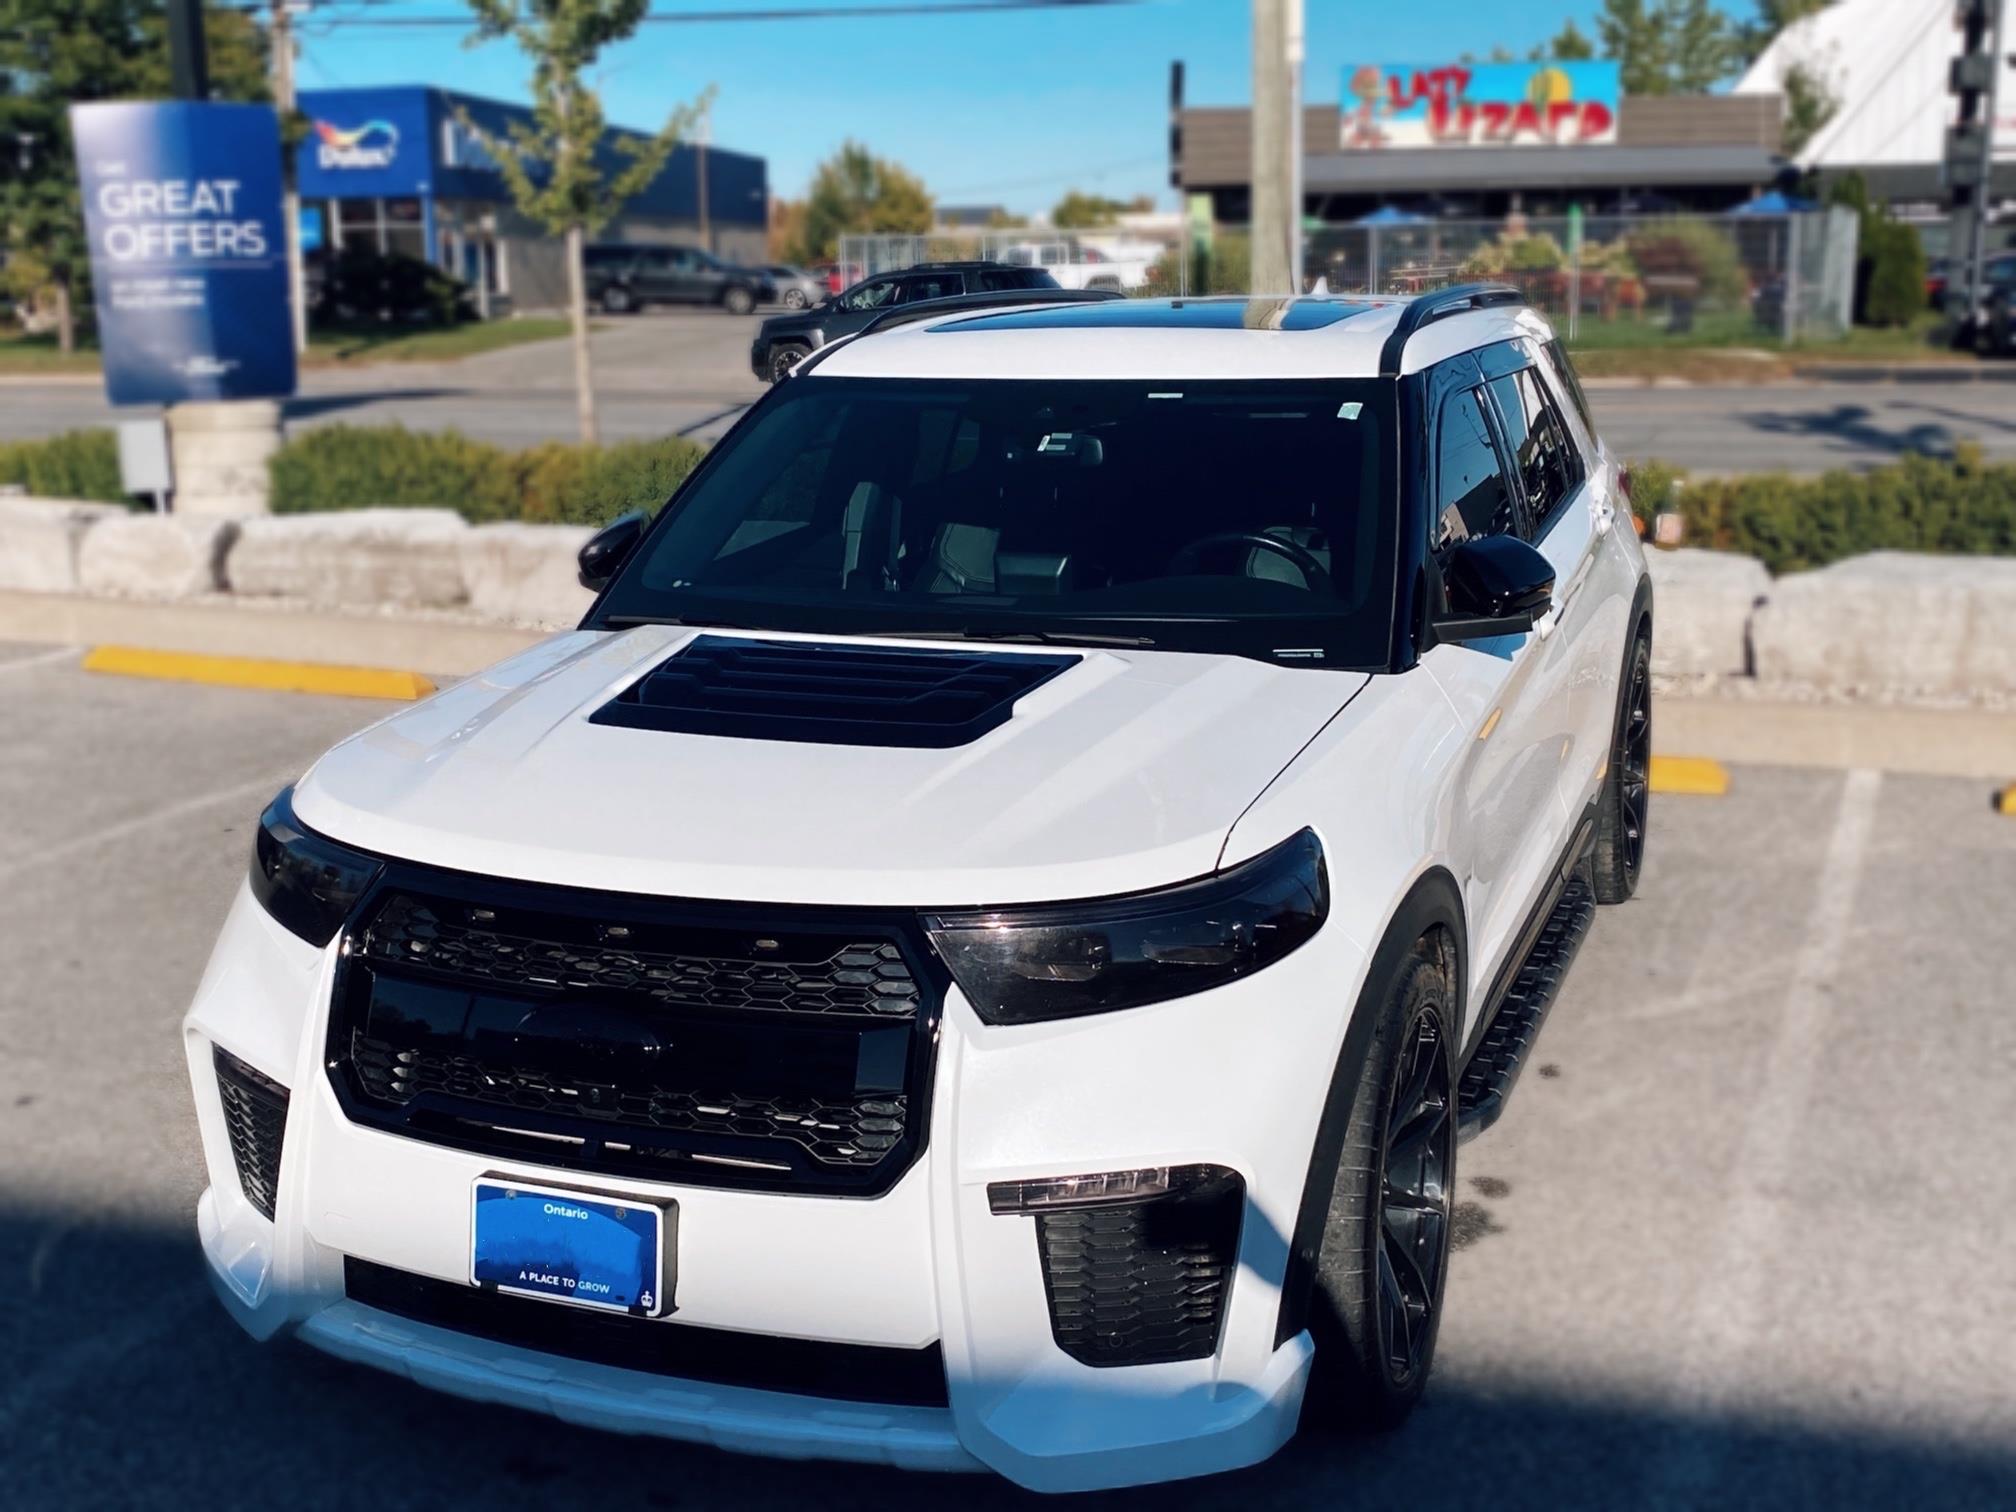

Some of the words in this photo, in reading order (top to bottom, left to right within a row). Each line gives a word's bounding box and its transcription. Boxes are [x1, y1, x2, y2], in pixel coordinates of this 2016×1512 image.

[100, 180, 240, 216] GREAT
[104, 221, 266, 260] OFFERS
[543, 1203, 589, 1220] Ontario
[519, 1271, 527, 1281] A
[528, 1272, 559, 1286] PLACE
[563, 1277, 576, 1288] TO
[578, 1280, 611, 1294] GROW
